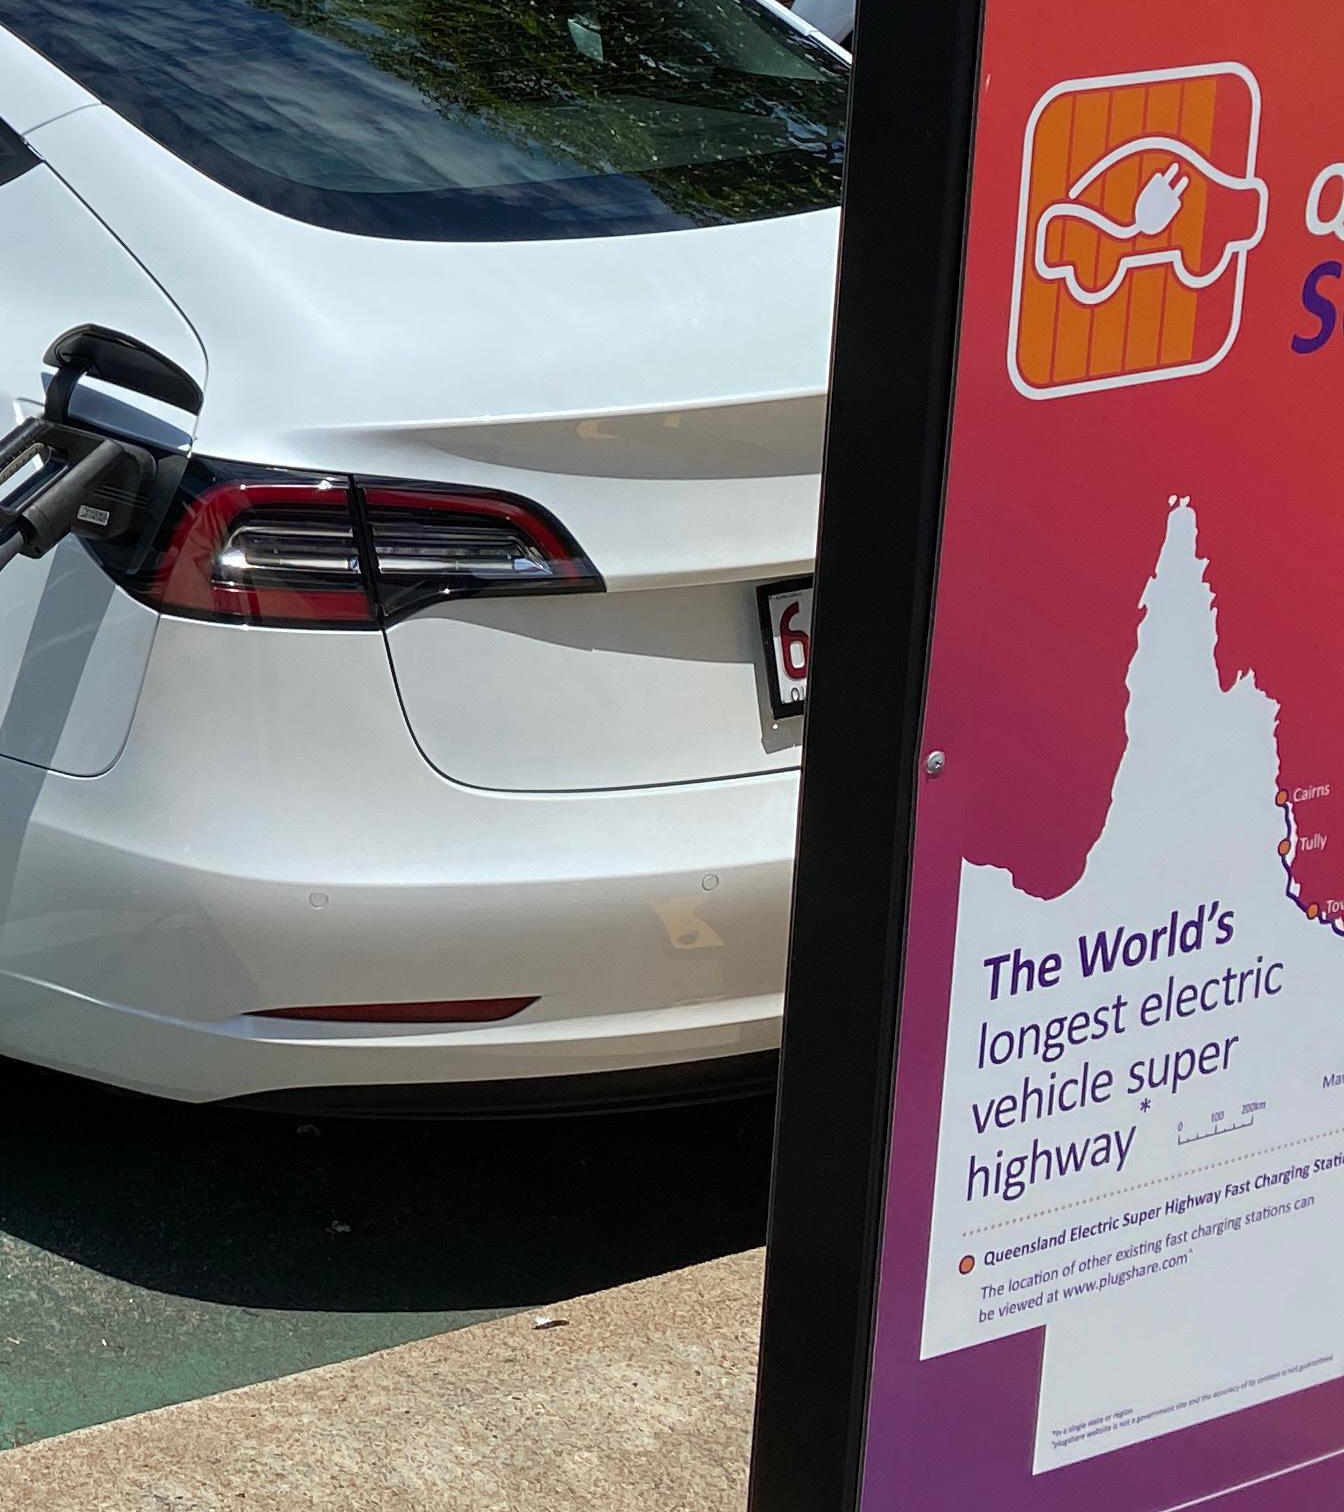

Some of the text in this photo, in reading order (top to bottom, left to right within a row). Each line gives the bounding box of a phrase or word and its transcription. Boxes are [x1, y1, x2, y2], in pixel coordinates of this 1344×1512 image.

[1291, 260, 1344, 354] S
[1293, 783, 1330, 802] Cairns
[1300, 833, 1328, 851] Tully
[978, 955, 1284, 1069] longest electric
[983, 948, 1062, 1000] The
[972, 1035, 1239, 1134] vehicle super
[981, 1195, 1315, 1300] The location of other existing fast charging stations can
[984, 1229, 1067, 1266] Queensland
[1070, 1216, 1119, 1242] Electric
[1122, 1206, 1162, 1226] Super
[1165, 1189, 1222, 1215] Highway
[1224, 1180, 1251, 1199] Fast
[1254, 1163, 1311, 1189] Charging
[978, 1308, 995, 1324] be
[998, 1290, 1043, 1317] viewed
[1046, 1289, 1060, 1304] at
